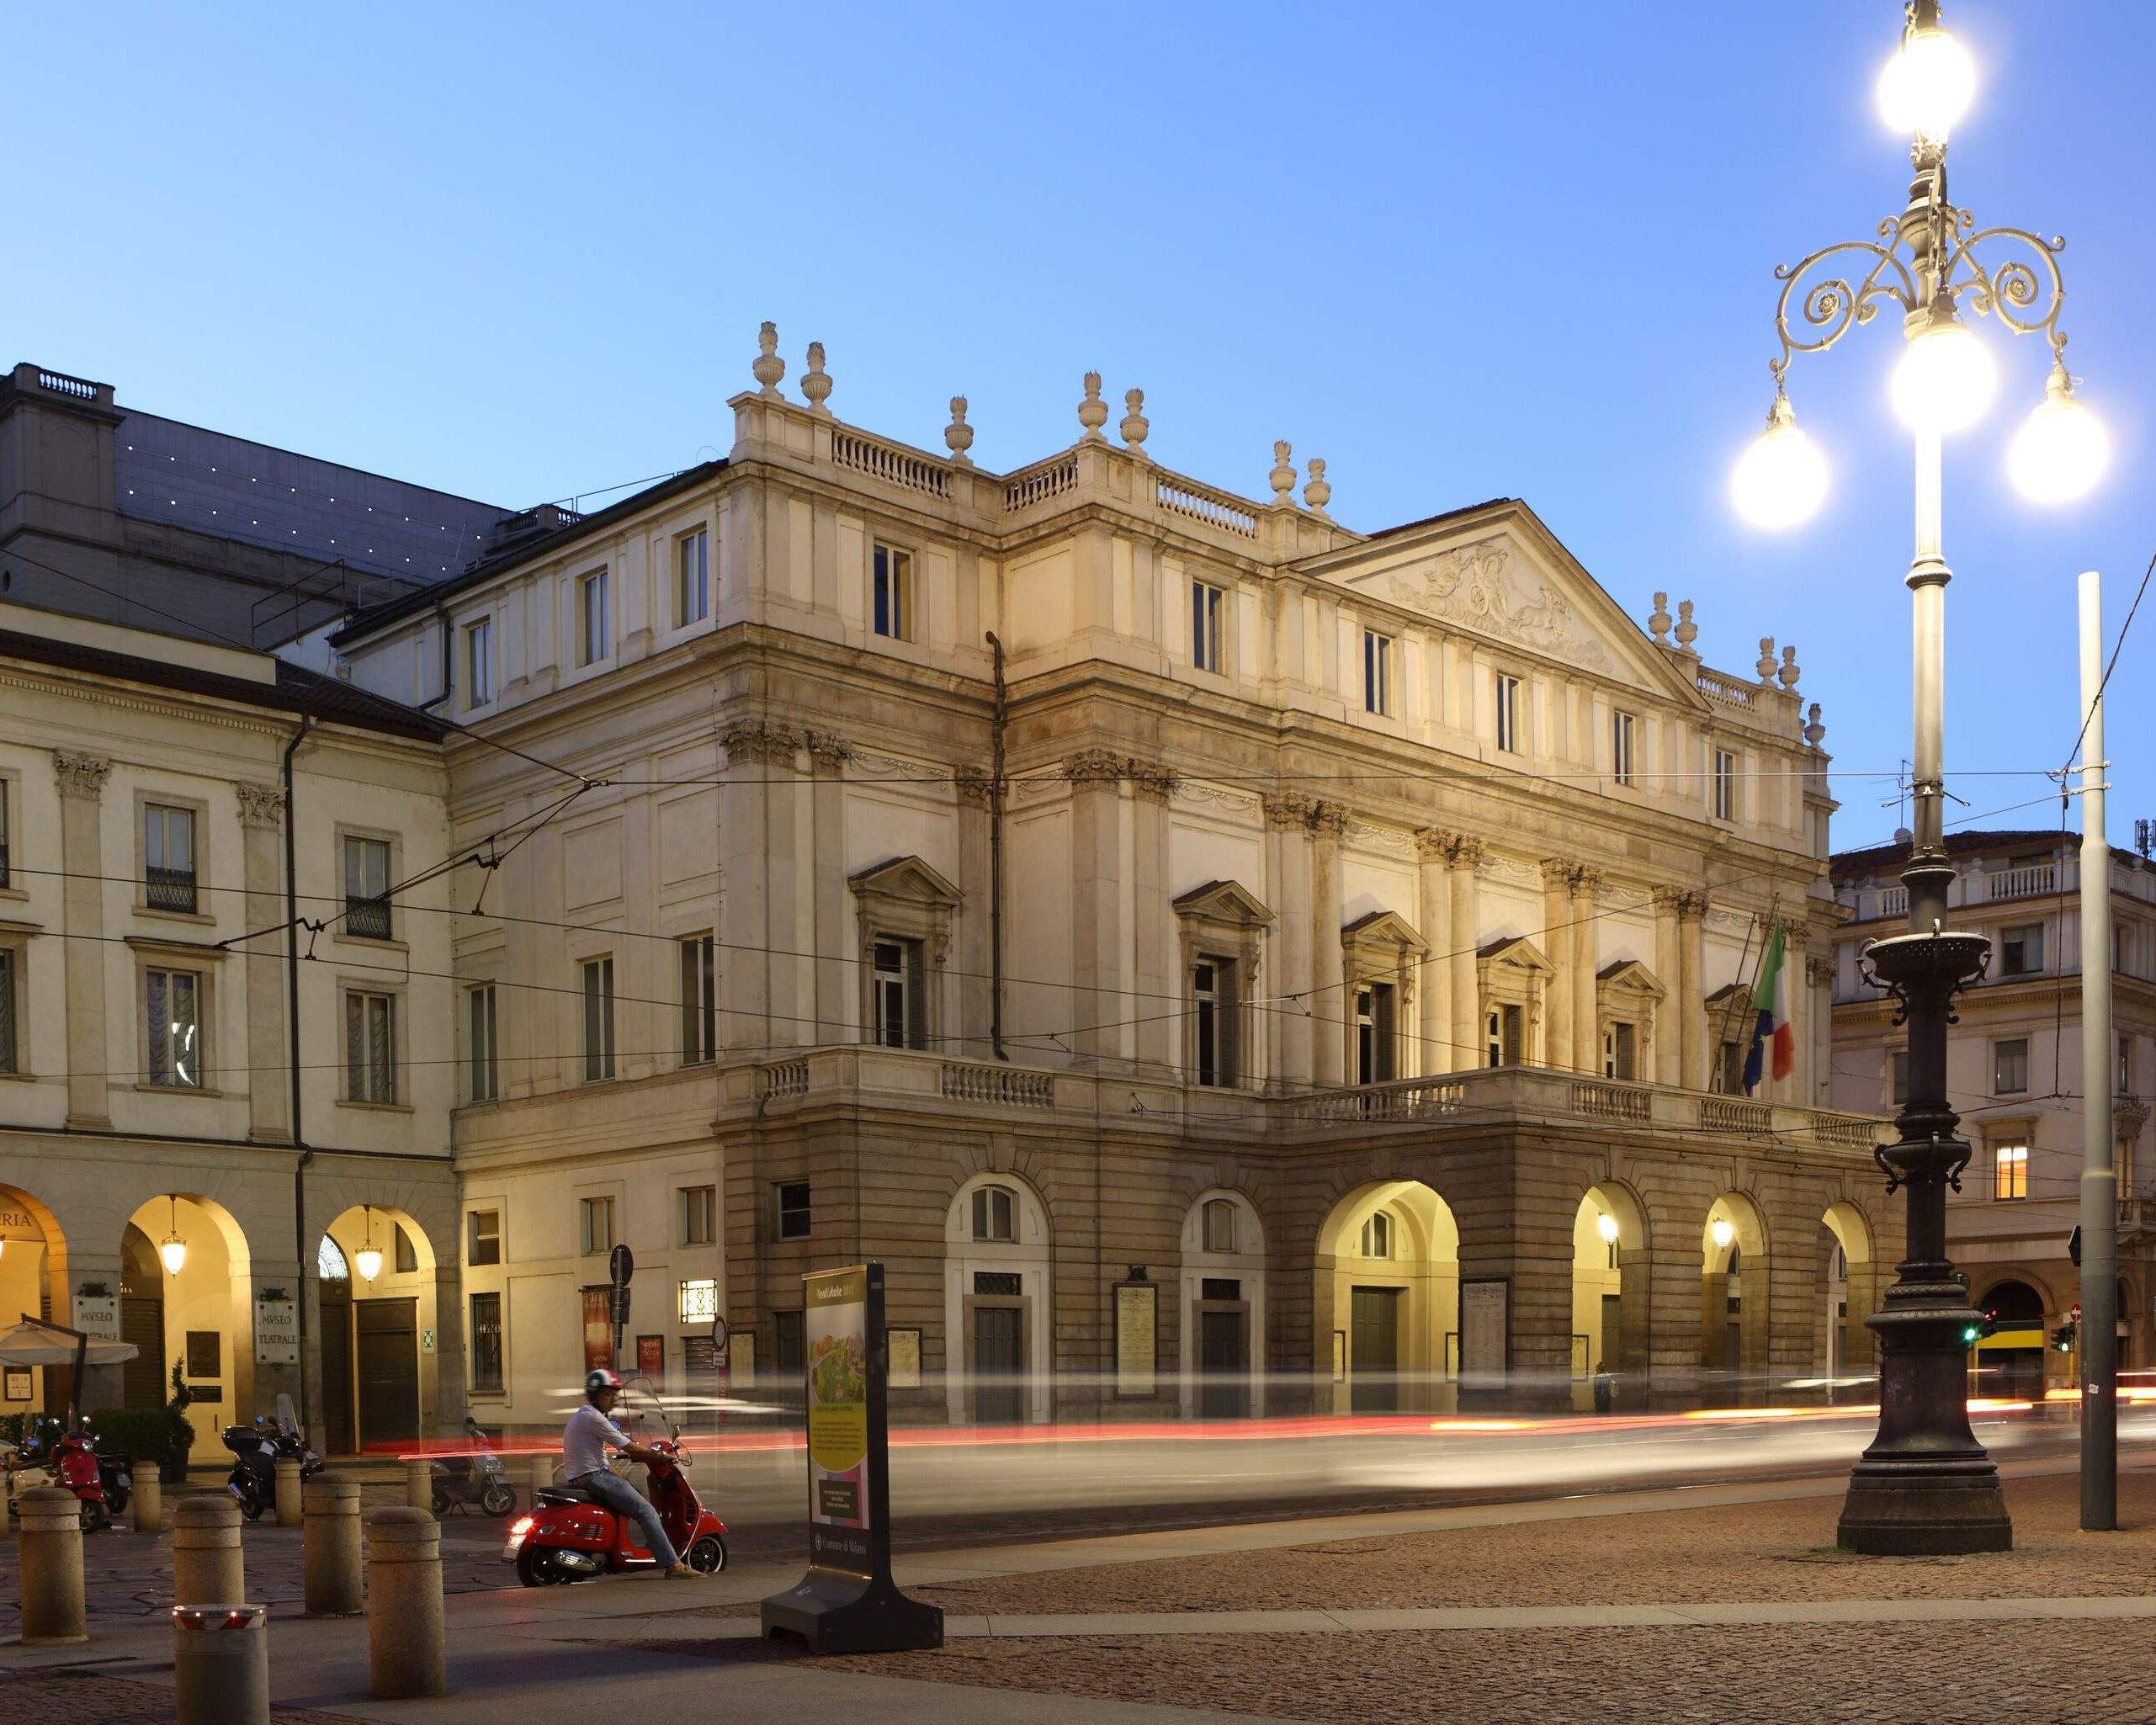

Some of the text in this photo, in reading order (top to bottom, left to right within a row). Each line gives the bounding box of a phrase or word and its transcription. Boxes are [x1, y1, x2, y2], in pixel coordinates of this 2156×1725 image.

[258, 1335, 296, 1344] TEATRALE
[823, 1537, 867, 1555] Comune di Milano
